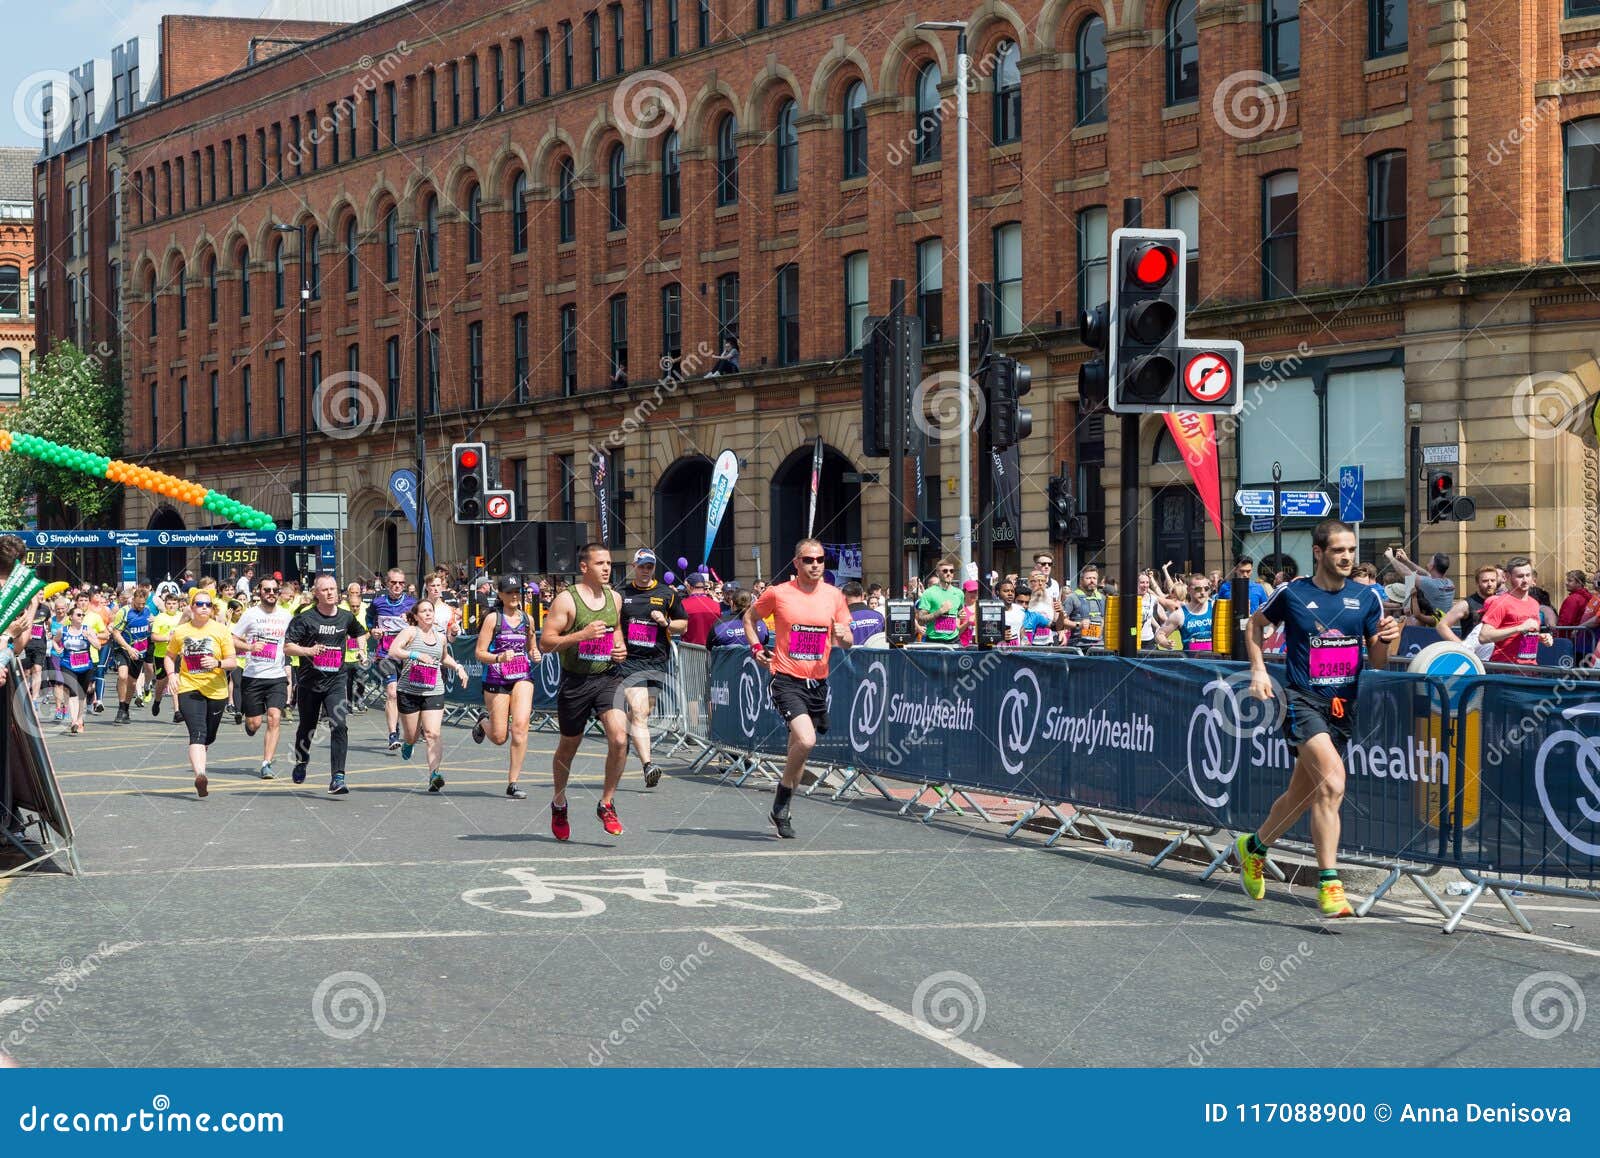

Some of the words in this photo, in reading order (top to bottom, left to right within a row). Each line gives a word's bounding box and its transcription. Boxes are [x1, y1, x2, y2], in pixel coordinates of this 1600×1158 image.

[1425, 446, 1457, 455] PORTLAND
[1429, 454, 1453, 463] STREET
[50, 534, 100, 544] Simplyhealth
[171, 534, 219, 543] Simplyhealth
[288, 533, 334, 543] Simplyhealth
[318, 624, 336, 635] RUN
[888, 693, 974, 735] Simplyhealth
[1042, 706, 1155, 755] Simplyhealth
